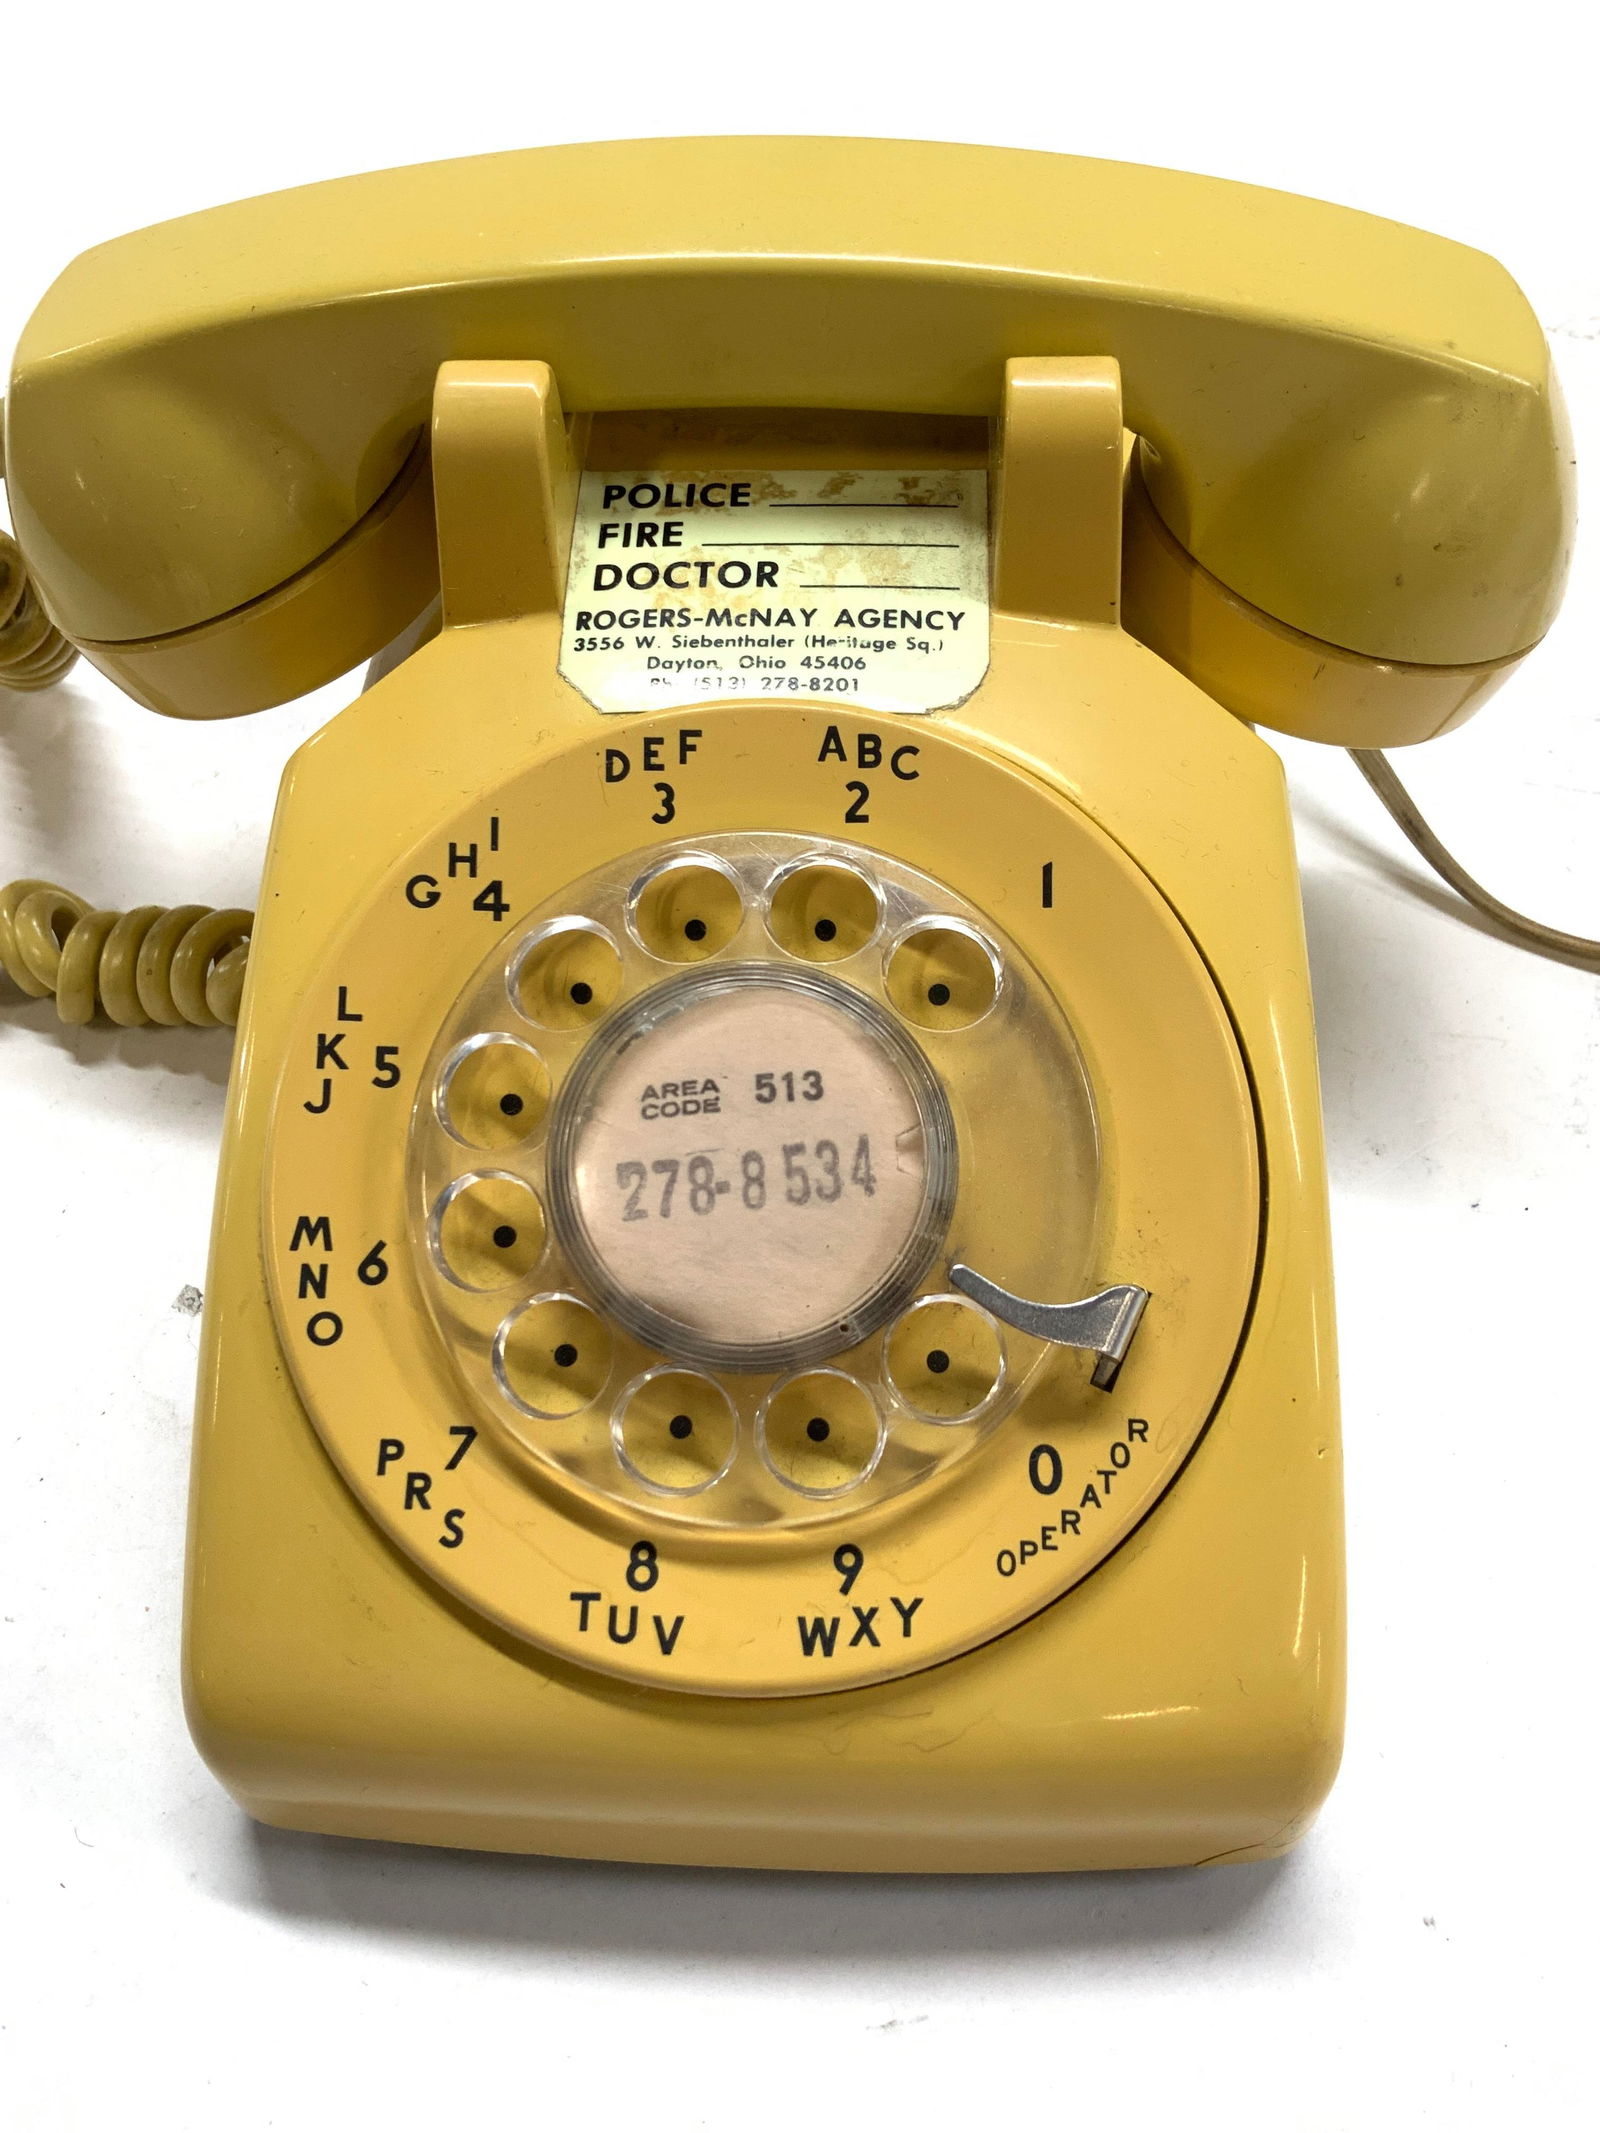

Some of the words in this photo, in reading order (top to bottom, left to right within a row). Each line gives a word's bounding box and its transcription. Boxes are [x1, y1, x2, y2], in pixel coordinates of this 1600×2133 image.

[602, 482, 752, 509] POLICE
[598, 521, 684, 549] FIRE
[593, 560, 779, 591] DOCTOR
[575, 607, 818, 631] ROGERS-McNAY
[833, 608, 966, 631] AGENCY
[573, 636, 625, 652] 3556
[635, 635, 661, 650] W.
[671, 634, 795, 649] Siebenthaler
[906, 636, 943, 655] Sq.)
[647, 655, 723, 674] Dayton,
[739, 655, 786, 669] Ohio
[800, 655, 867, 671] 45406
[760, 676, 859, 693] 278-8201
[651, 782, 676, 825] 3
[844, 780, 870, 824] 2
[472, 880, 510, 922] 4
[1042, 861, 1053, 909] 1
[371, 1045, 401, 1089] 5
[641, 1078, 720, 1103] AREA
[755, 1070, 824, 1104] 513
[641, 1098, 721, 1120] CODE
[357, 1239, 389, 1286] 6
[444, 1425, 479, 1471] 7
[626, 1539, 659, 1592] 8
[833, 1542, 864, 1596] 9
